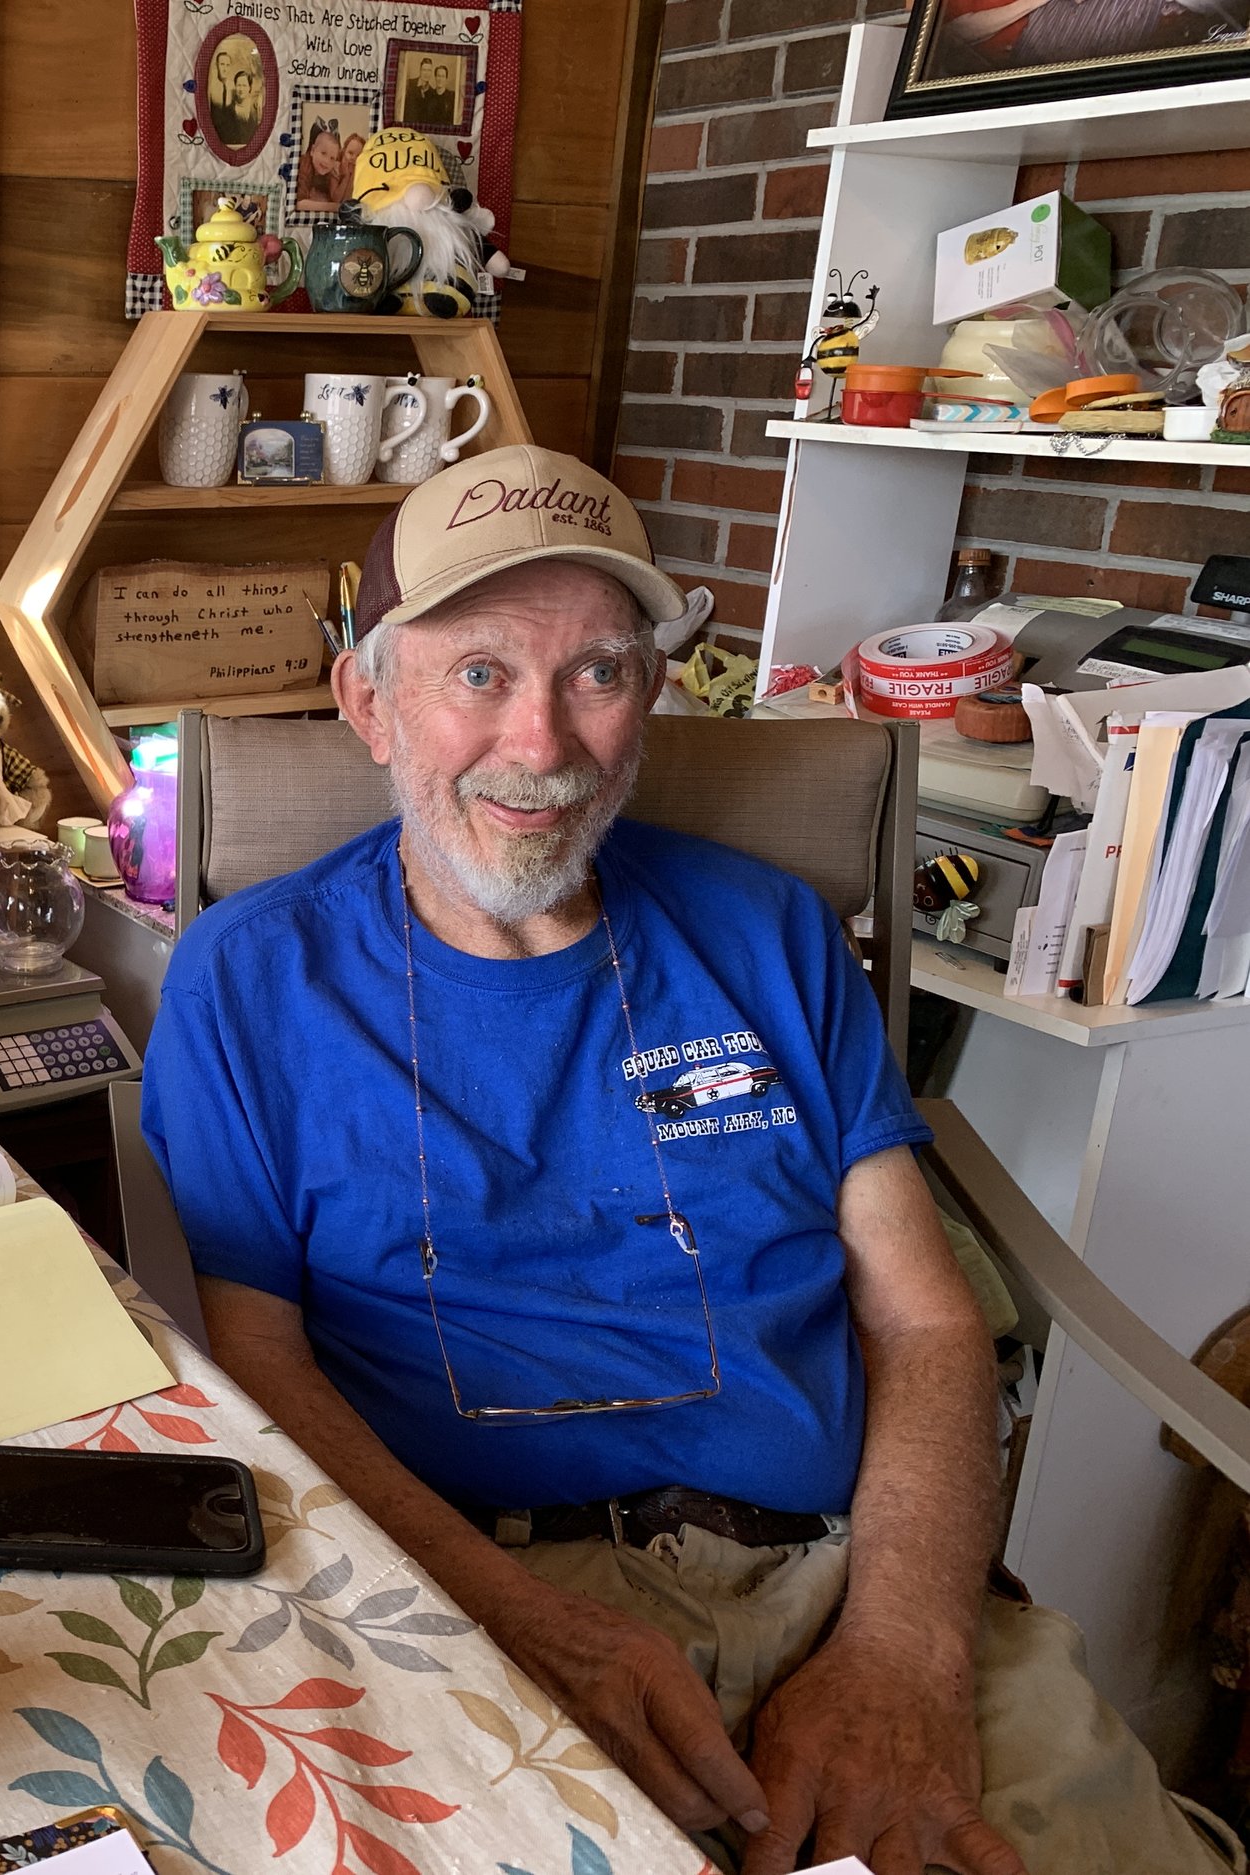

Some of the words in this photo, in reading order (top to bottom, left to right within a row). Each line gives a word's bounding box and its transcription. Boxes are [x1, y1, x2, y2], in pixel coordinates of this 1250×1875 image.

[226, 0, 281, 21] Families
[286, 5, 315, 24] That
[321, 9, 344, 27] Are
[346, 14, 398, 32] Stitched
[401, 15, 447, 38] Together
[306, 35, 333, 54] With
[343, 37, 373, 57] Love
[287, 59, 331, 78] Seldom
[445, 478, 612, 531] Dadant
[551, 512, 578, 526] est.
[583, 517, 612, 537] 1863
[113, 586, 128, 600] I
[135, 588, 159, 600] can
[172, 584, 188, 597] do
[206, 585, 225, 597] all
[242, 583, 288, 597] things
[1212, 591, 1250, 606] SHARP
[123, 611, 179, 626] through
[197, 606, 249, 620] Christ
[263, 604, 293, 616] who
[115, 628, 220, 644] strengtheneth
[240, 624, 273, 637] me.
[209, 663, 276, 679] Philippians
[888, 682, 953, 696] FRAGILE
[622, 1045, 680, 1081] SQUAD
[681, 1036, 723, 1063] CAR
[722, 1031, 768, 1056] TOU
[656, 1118, 720, 1142] MOUNT
[724, 1111, 769, 1134] AIRY,
[771, 1106, 797, 1125] NC
